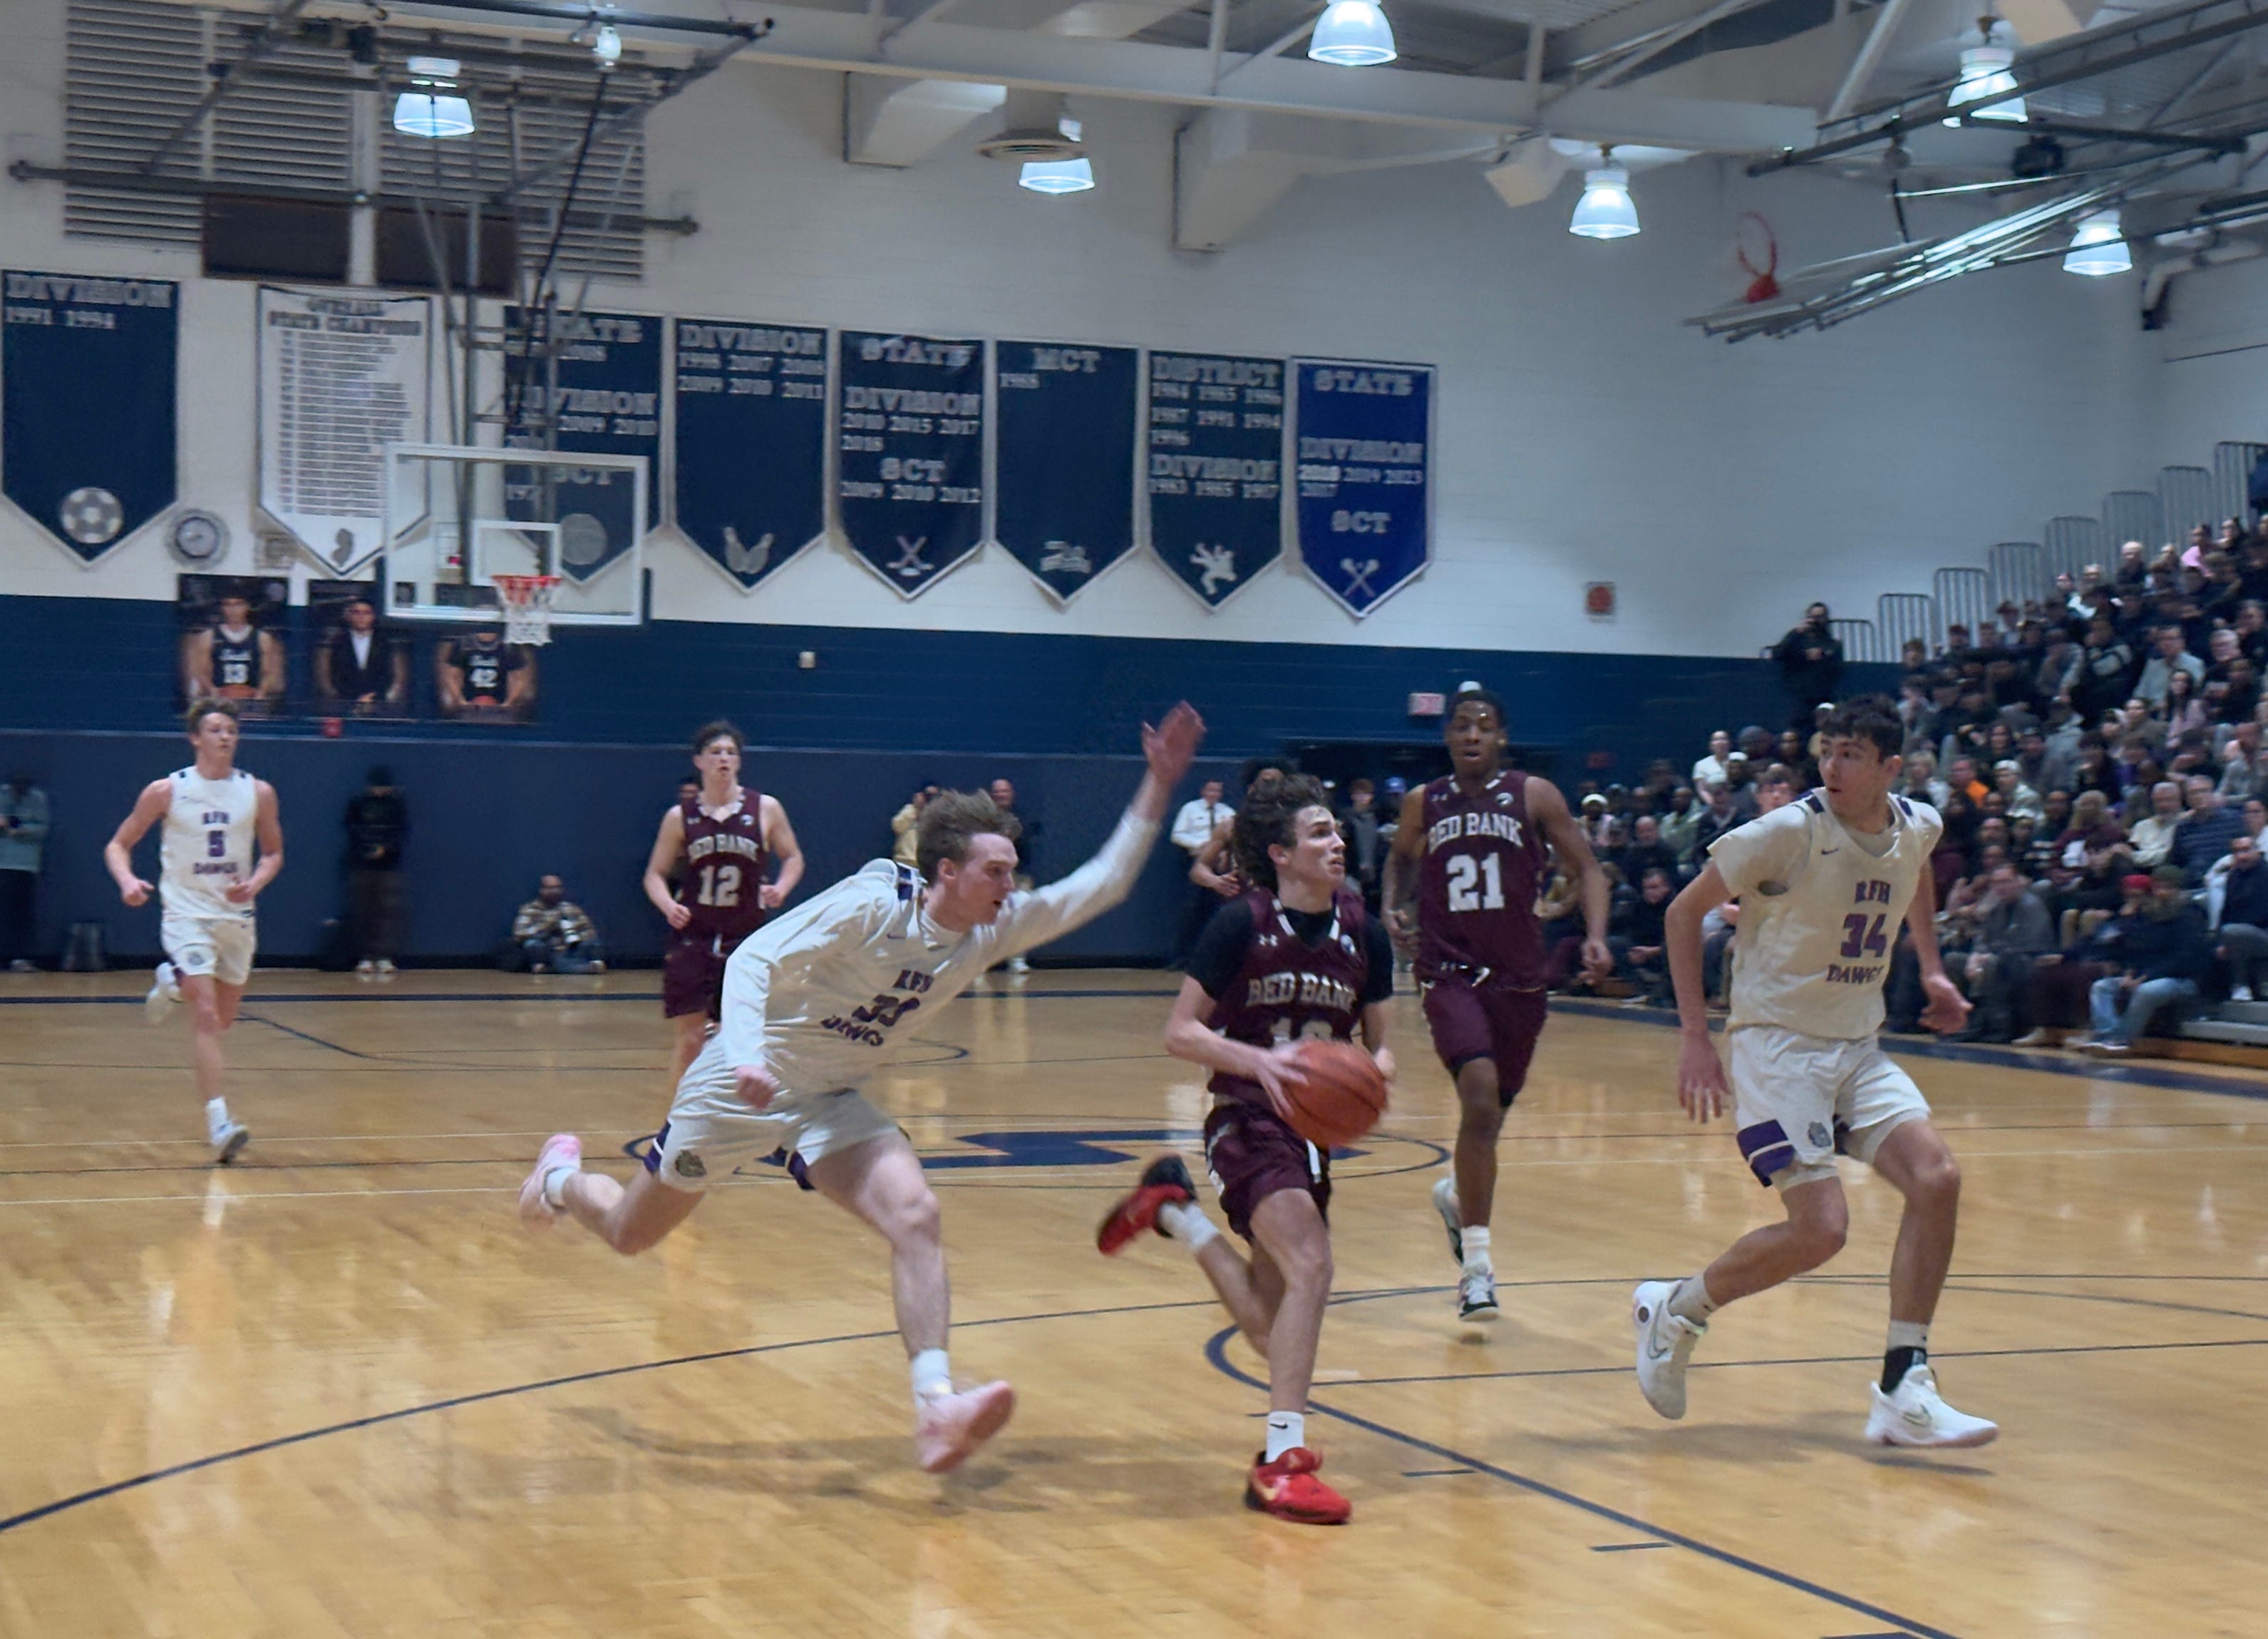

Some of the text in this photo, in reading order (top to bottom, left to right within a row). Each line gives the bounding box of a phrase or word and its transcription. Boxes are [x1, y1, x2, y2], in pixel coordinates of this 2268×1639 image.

[6, 273, 173, 308] DIVISION
[679, 324, 823, 355] DIVISION
[860, 336, 977, 367] STATE
[1152, 355, 1280, 387] DISTRICT
[1313, 369, 1415, 396] STATE
[845, 386, 981, 416] DIVISION
[1299, 437, 1424, 464] DIVISION
[880, 456, 946, 483] SCT
[1150, 453, 1277, 483] DIVISION
[1331, 509, 1392, 534] SCT
[470, 669, 498, 688] 42
[208, 830, 226, 858] 5
[688, 833, 760, 863] RED BANK
[1428, 811, 1525, 855] RED BANK
[697, 865, 743, 908] 12
[1446, 852, 1505, 913] 21
[1840, 913, 1888, 958] 34
[1246, 972, 1358, 1014] RED BANK
